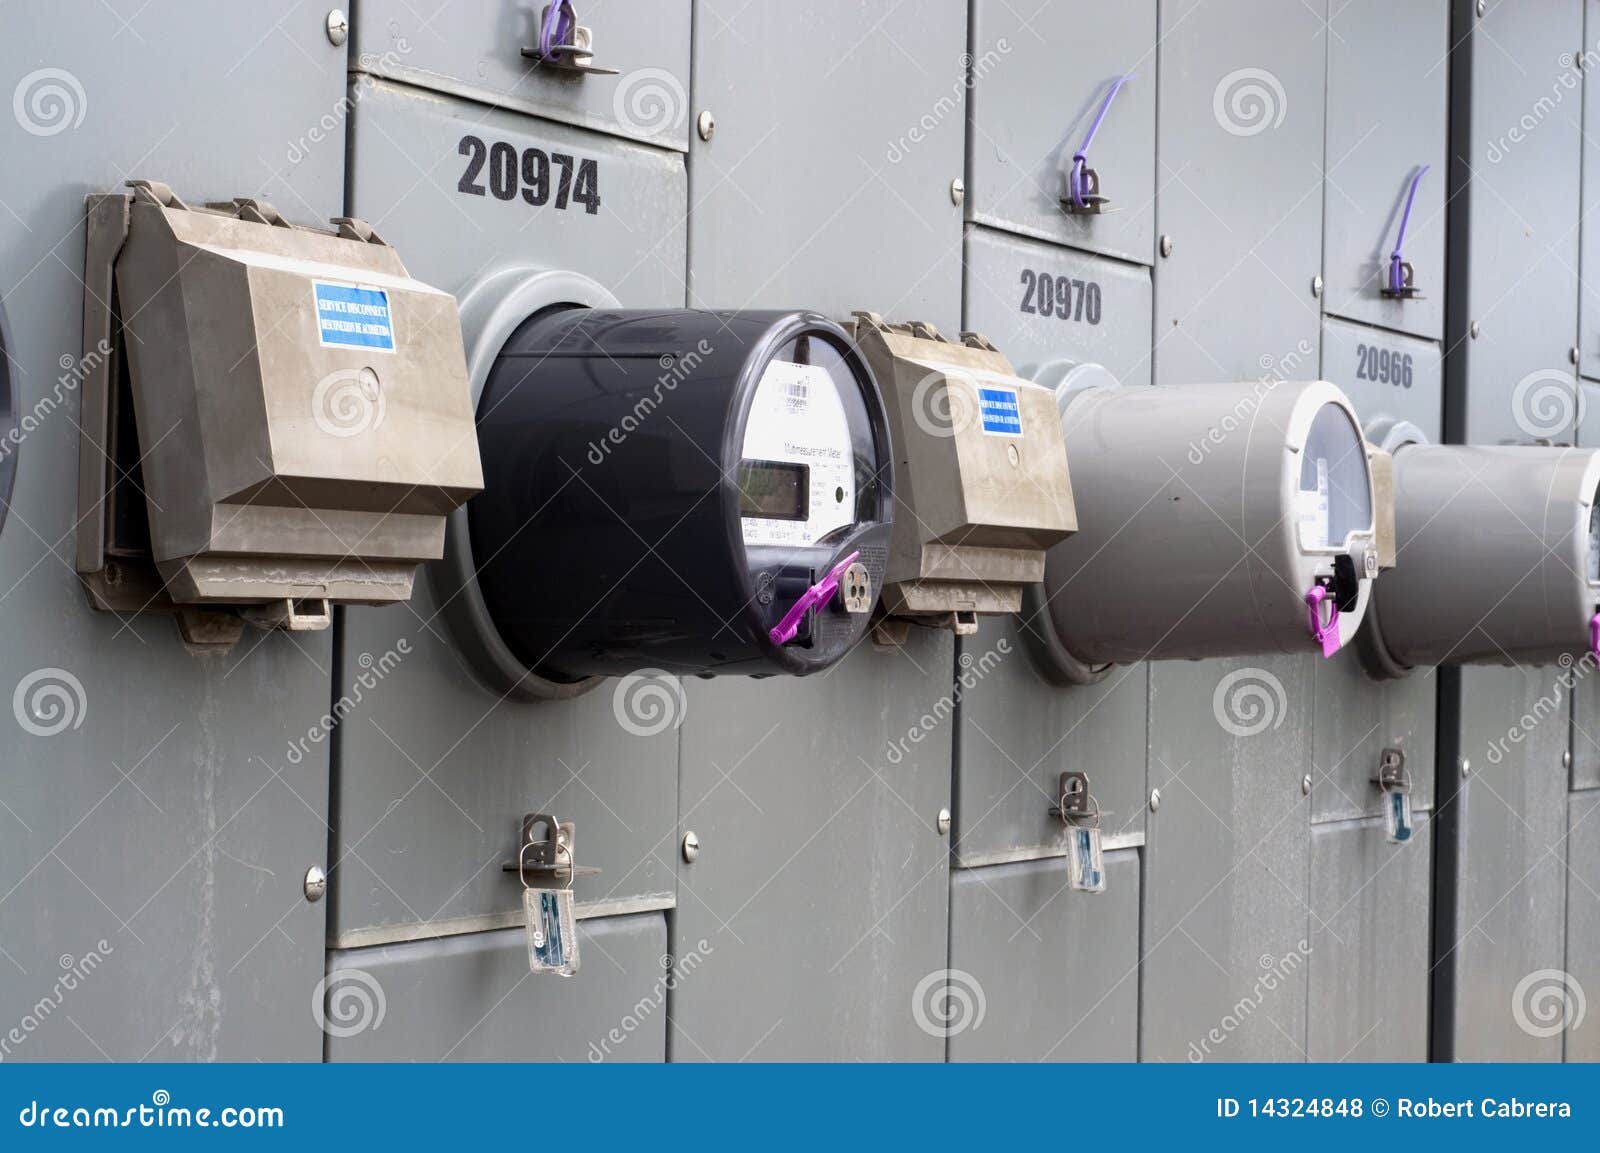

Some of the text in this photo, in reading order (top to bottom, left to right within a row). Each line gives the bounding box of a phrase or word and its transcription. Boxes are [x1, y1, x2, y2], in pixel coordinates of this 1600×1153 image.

[457, 135, 601, 216] 20974
[319, 299, 347, 313] SERVICE
[1020, 269, 1102, 325] 20970
[1356, 343, 1413, 389] 20966
